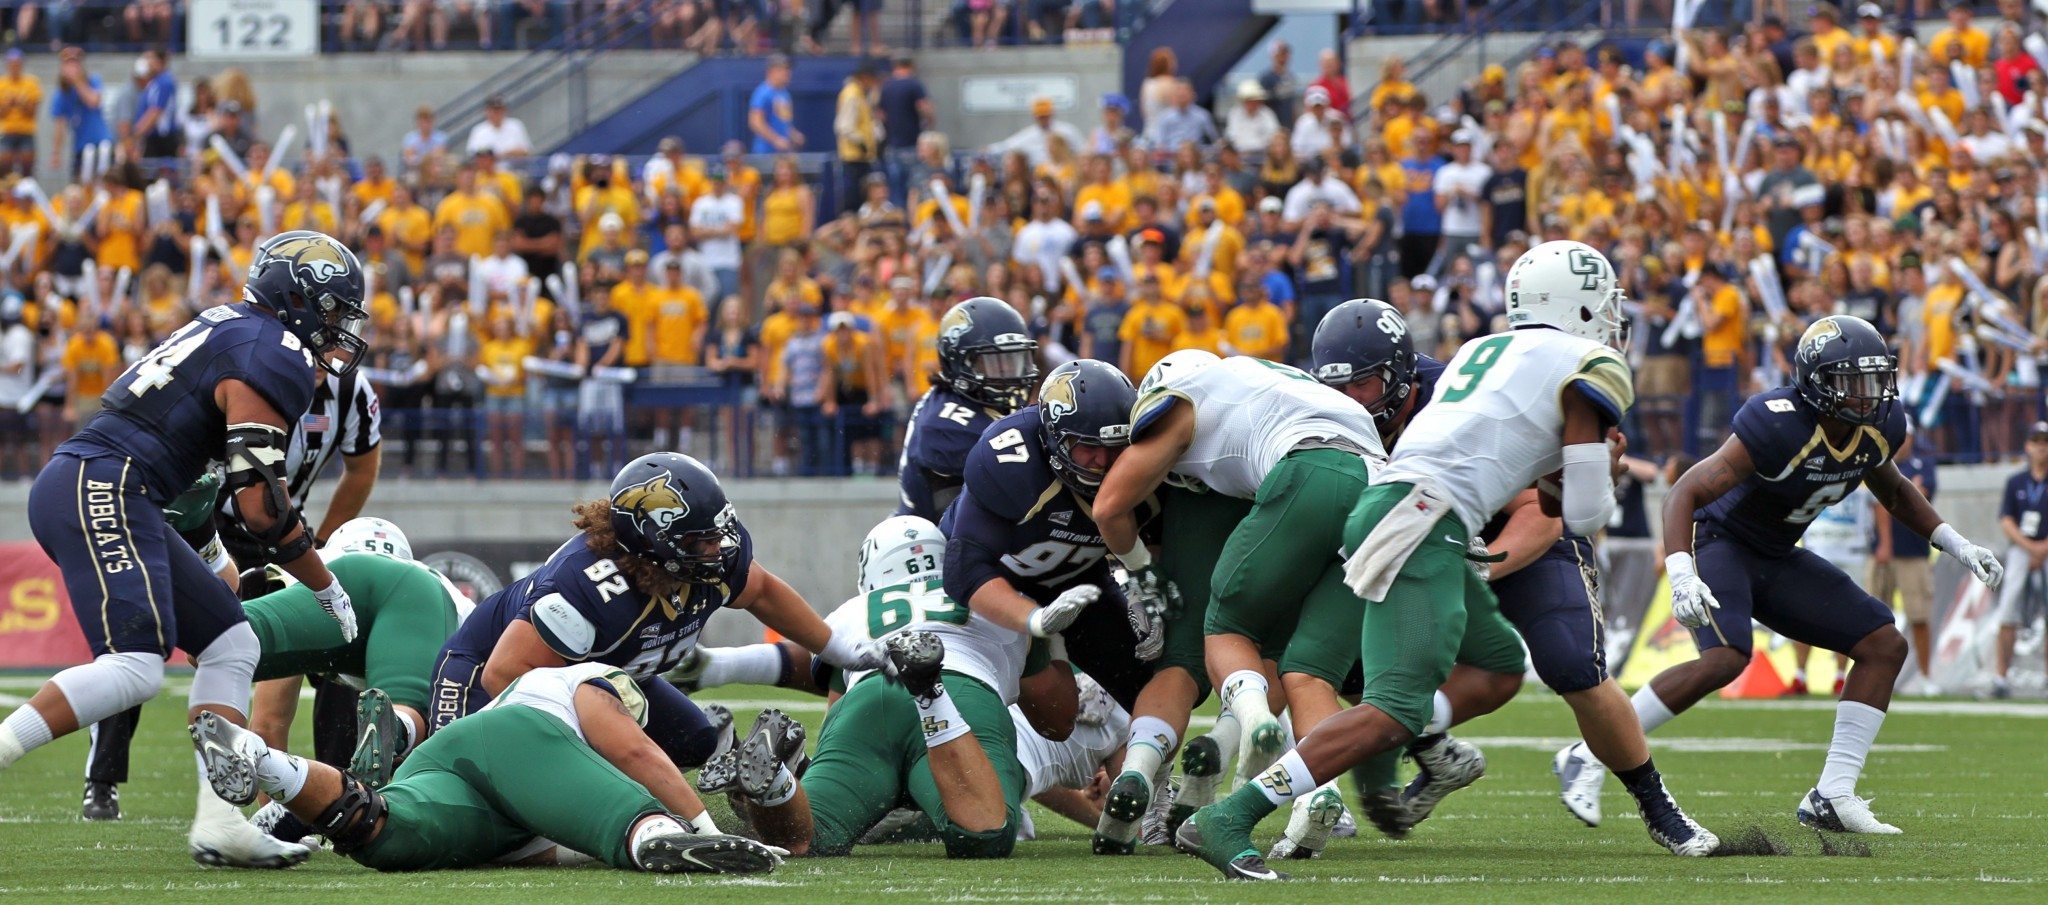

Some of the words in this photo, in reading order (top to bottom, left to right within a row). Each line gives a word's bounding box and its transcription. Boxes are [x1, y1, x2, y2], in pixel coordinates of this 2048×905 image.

[211, 15, 291, 48] 122
[1511, 291, 1519, 308] 9
[1376, 309, 1405, 344] 90
[1438, 335, 1514, 403] 9
[938, 402, 977, 427] 12
[988, 427, 1030, 464] 97
[1806, 473, 1841, 481] MONTANA
[87, 479, 134, 574] BOBCATS
[1050, 529, 1091, 543] MONTANA
[365, 540, 394, 554] 59
[583, 558, 629, 604] 92
[906, 554, 936, 575] 63
[1000, 540, 1107, 589] 97
[0, 577, 60, 635] S
[867, 580, 970, 640] 63
[641, 631, 676, 650] MONTANA
[678, 619, 700, 637] STATE
[1260, 763, 1292, 796] CP
